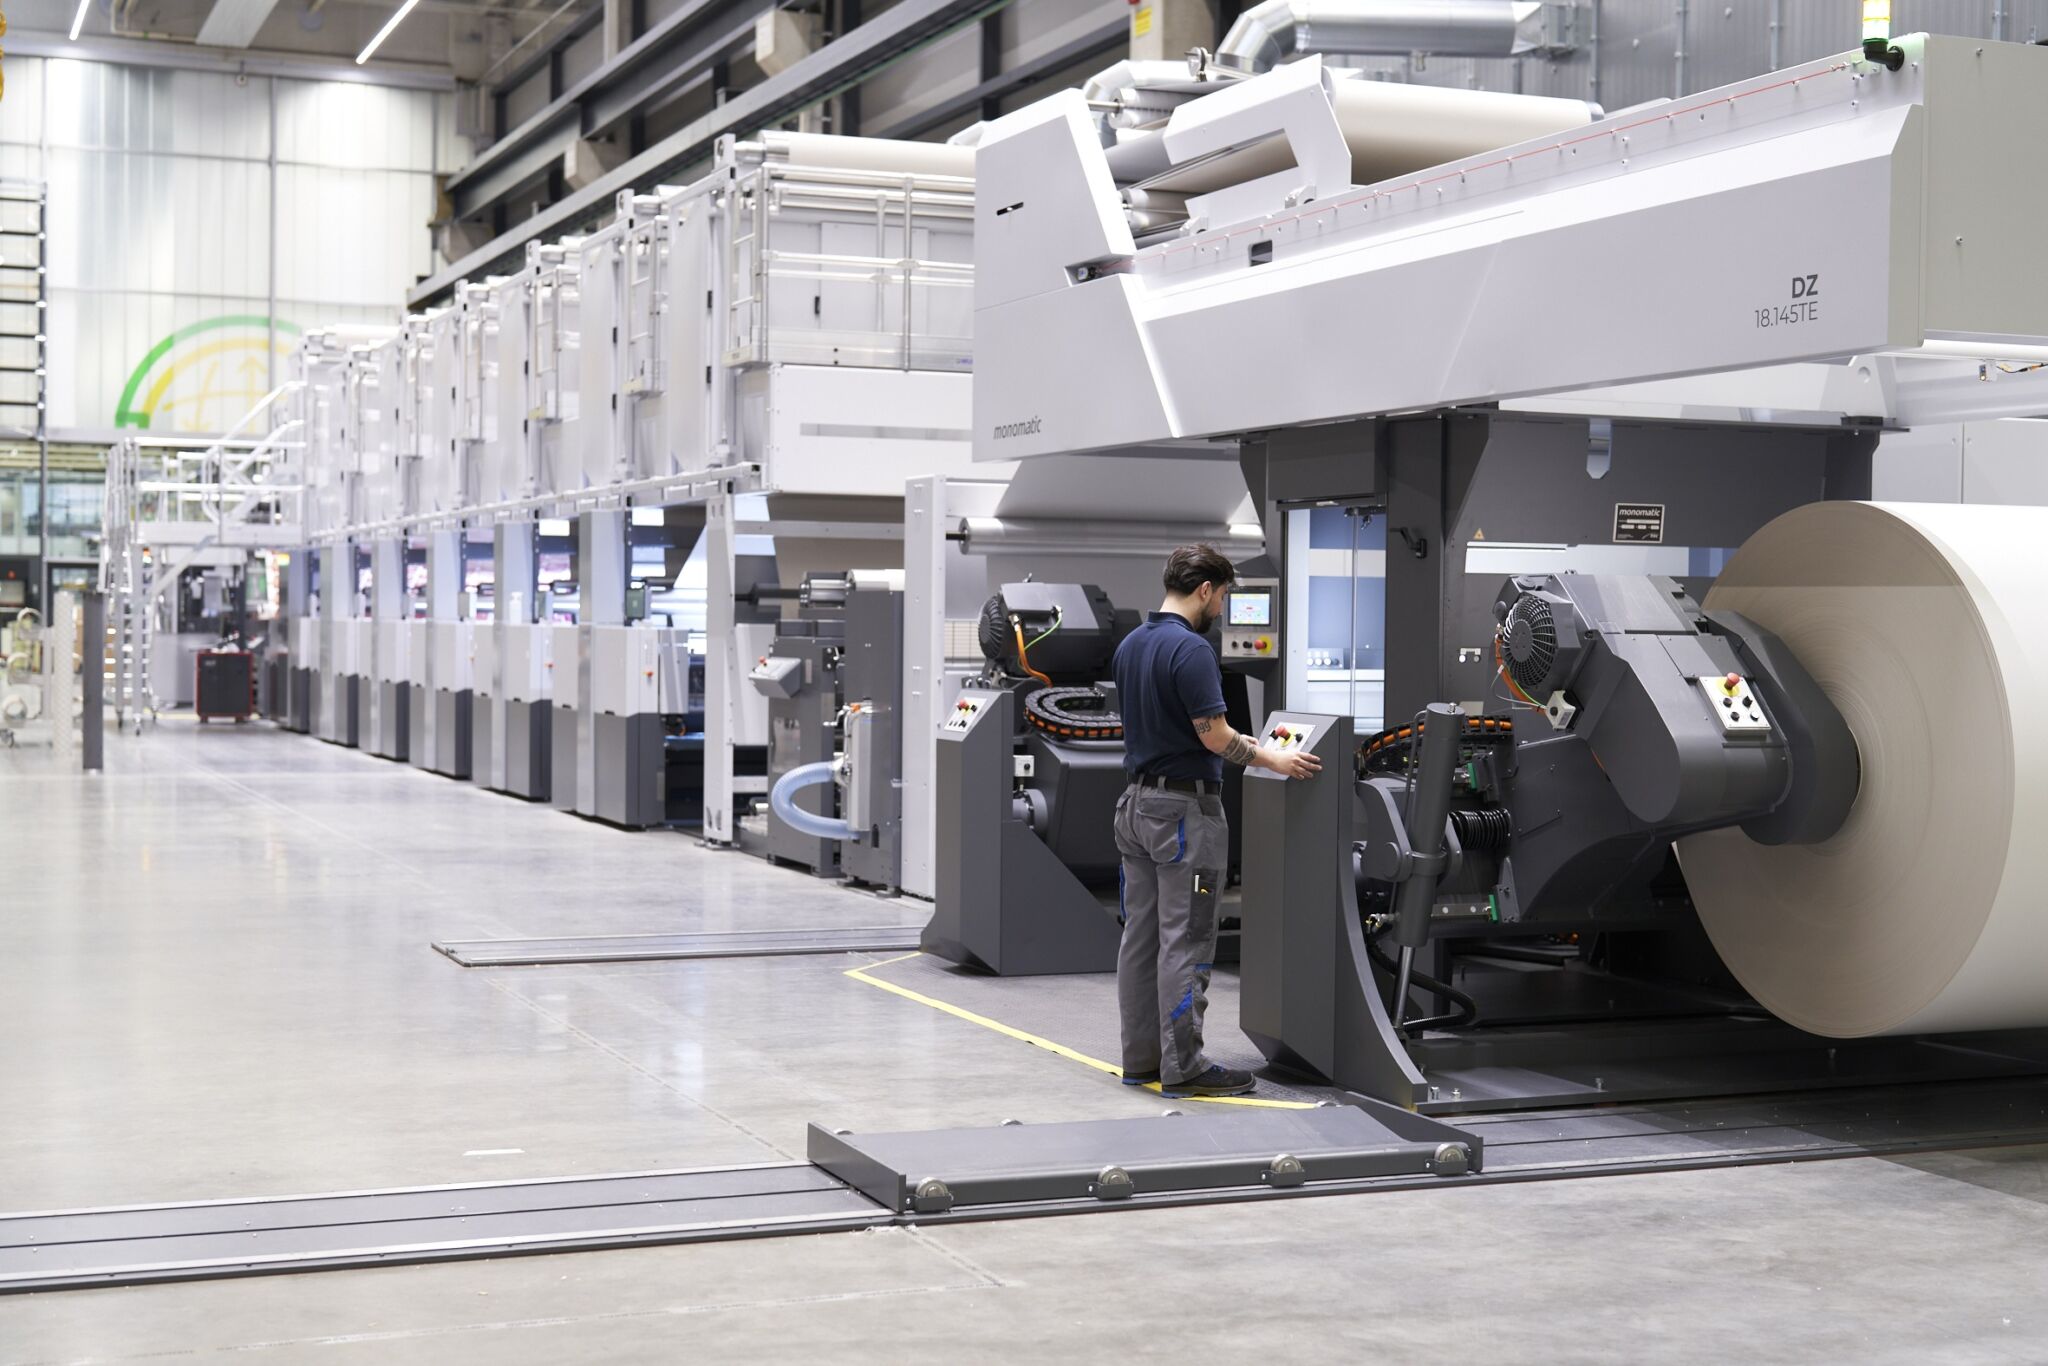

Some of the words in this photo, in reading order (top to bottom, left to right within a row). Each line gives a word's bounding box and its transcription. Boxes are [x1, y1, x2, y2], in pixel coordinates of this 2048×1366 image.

[1791, 274, 1818, 299] DZ
[1754, 301, 1818, 328] 18.145TE
[993, 414, 1042, 440] monomatic
[1619, 508, 1661, 517] monomatic
